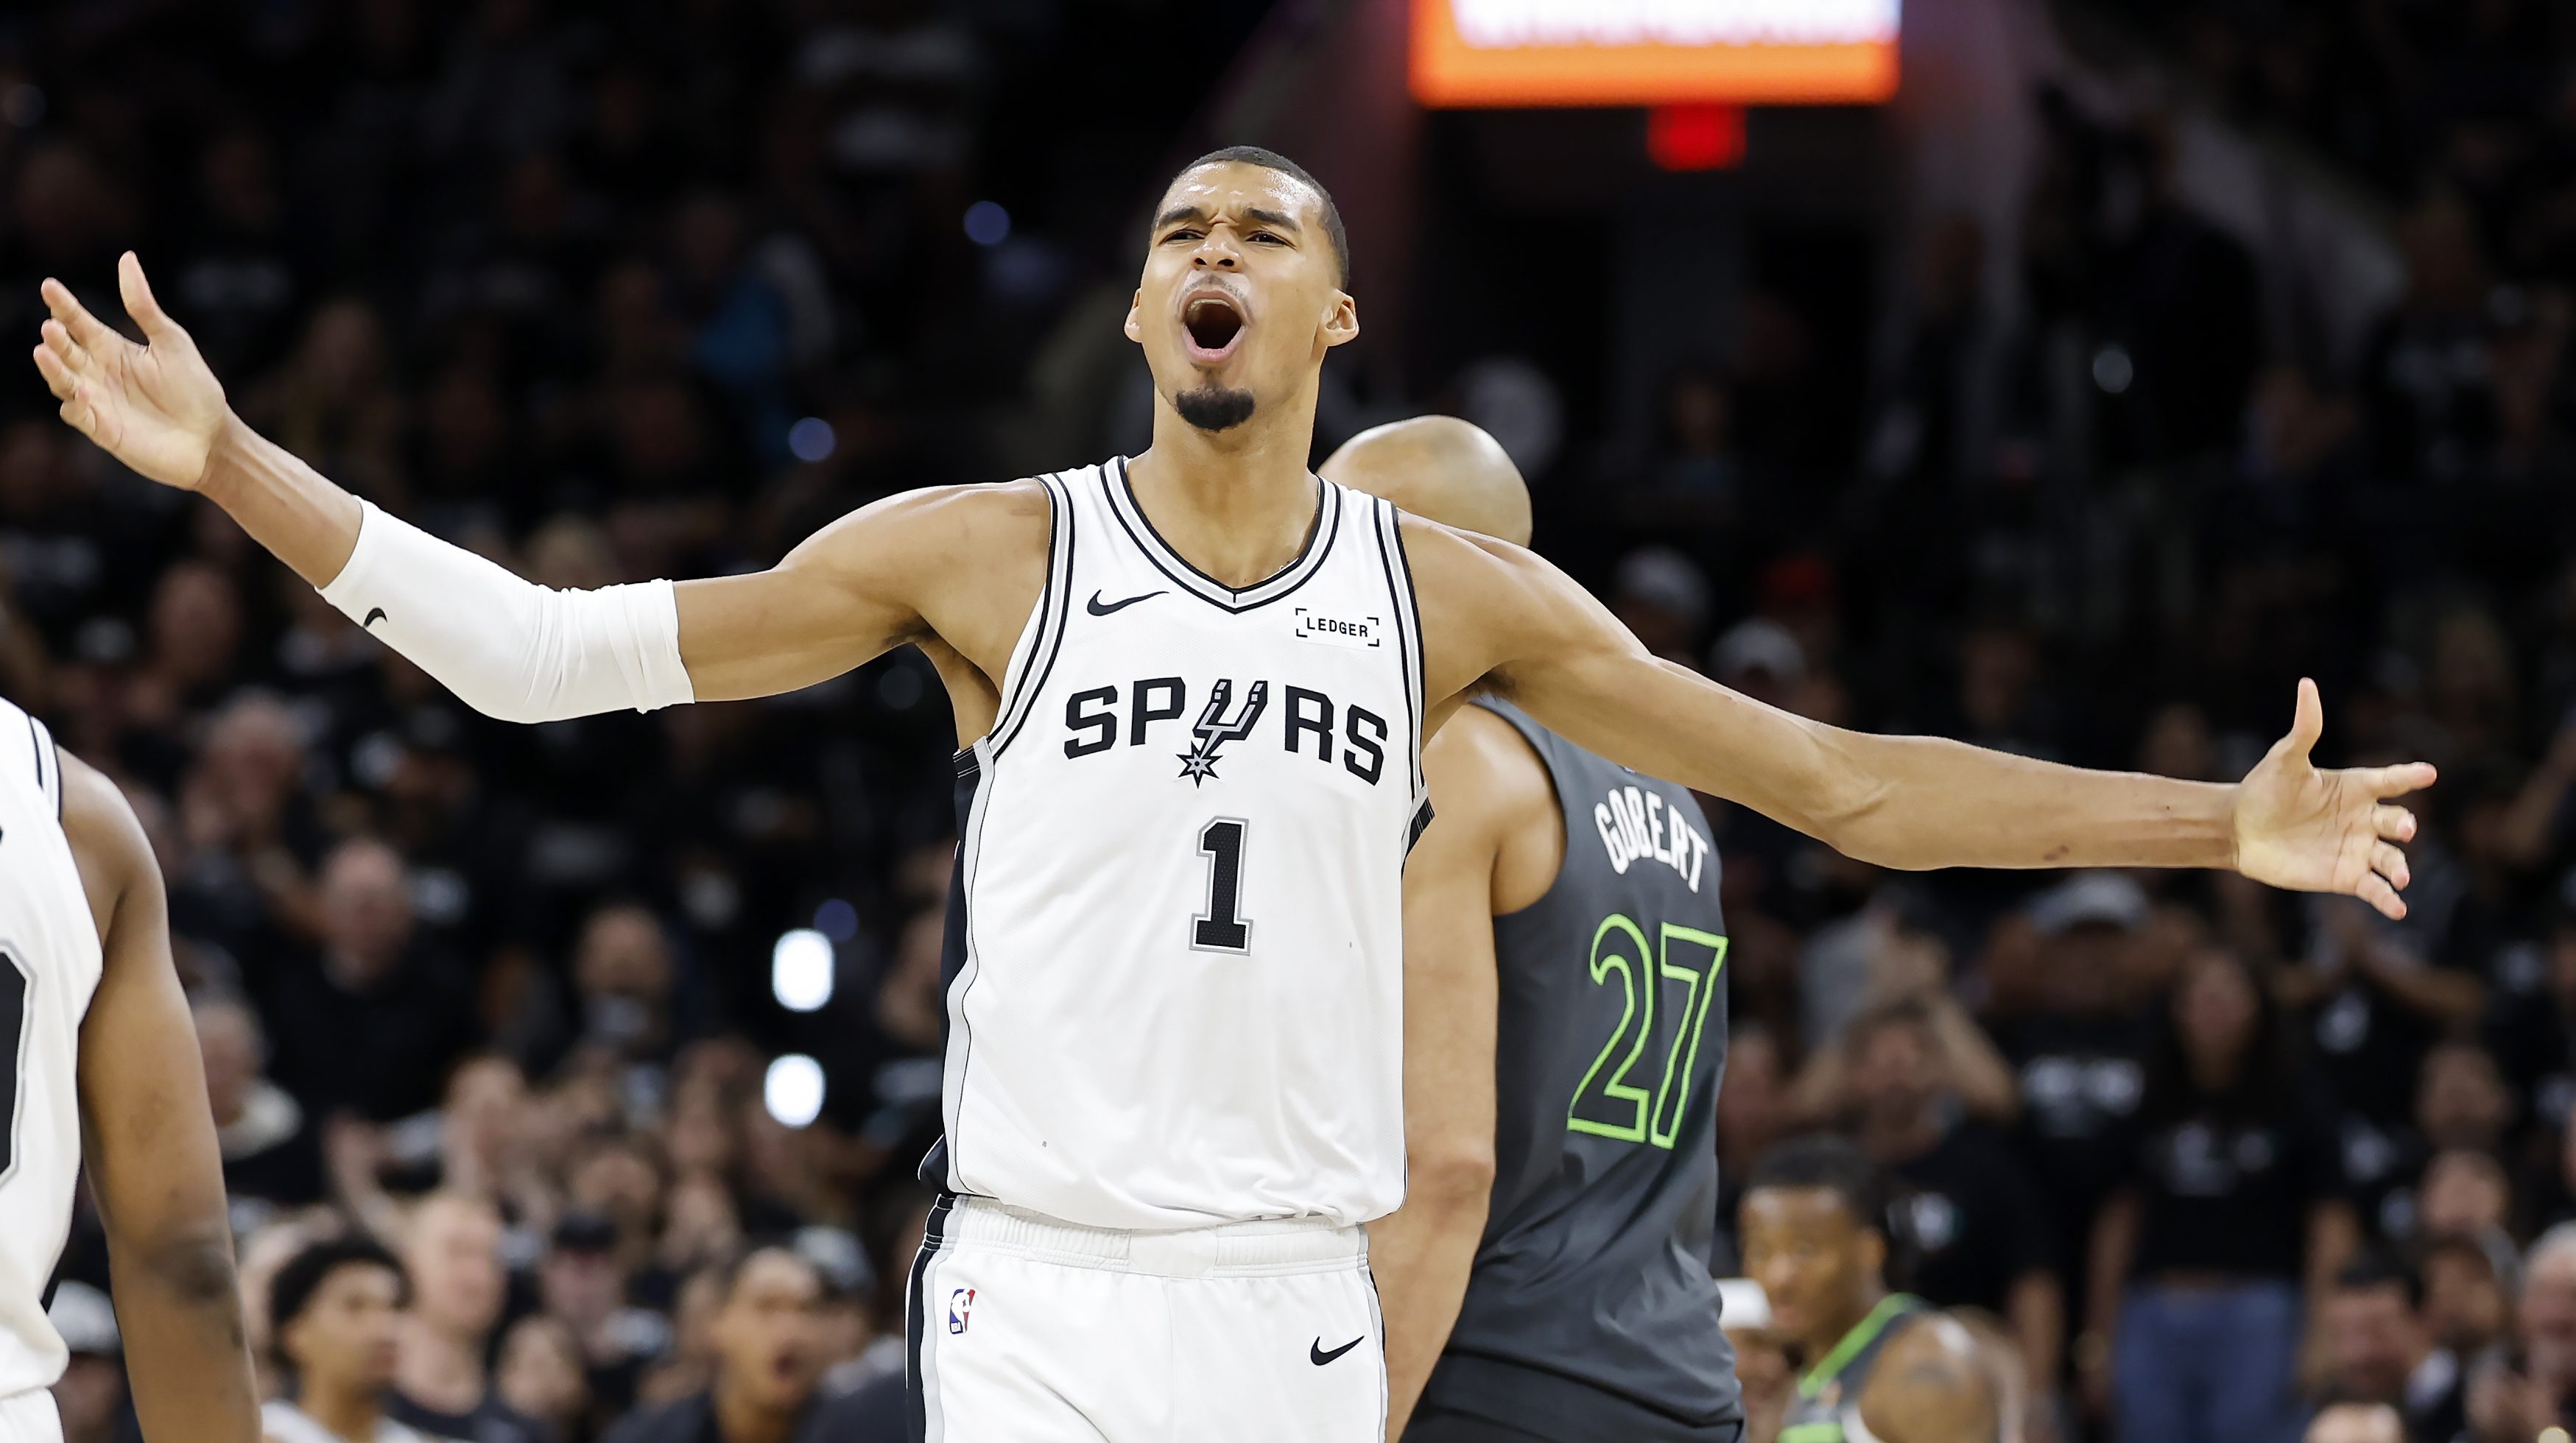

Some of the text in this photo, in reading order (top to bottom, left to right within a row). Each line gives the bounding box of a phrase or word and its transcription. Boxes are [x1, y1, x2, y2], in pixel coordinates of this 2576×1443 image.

[1306, 616, 1369, 638] LEDGER
[1064, 677, 1388, 788] SPURS
[1189, 815, 1254, 956] 1
[1594, 785, 1709, 894] GOBERT
[1566, 912, 1729, 1150] 27
